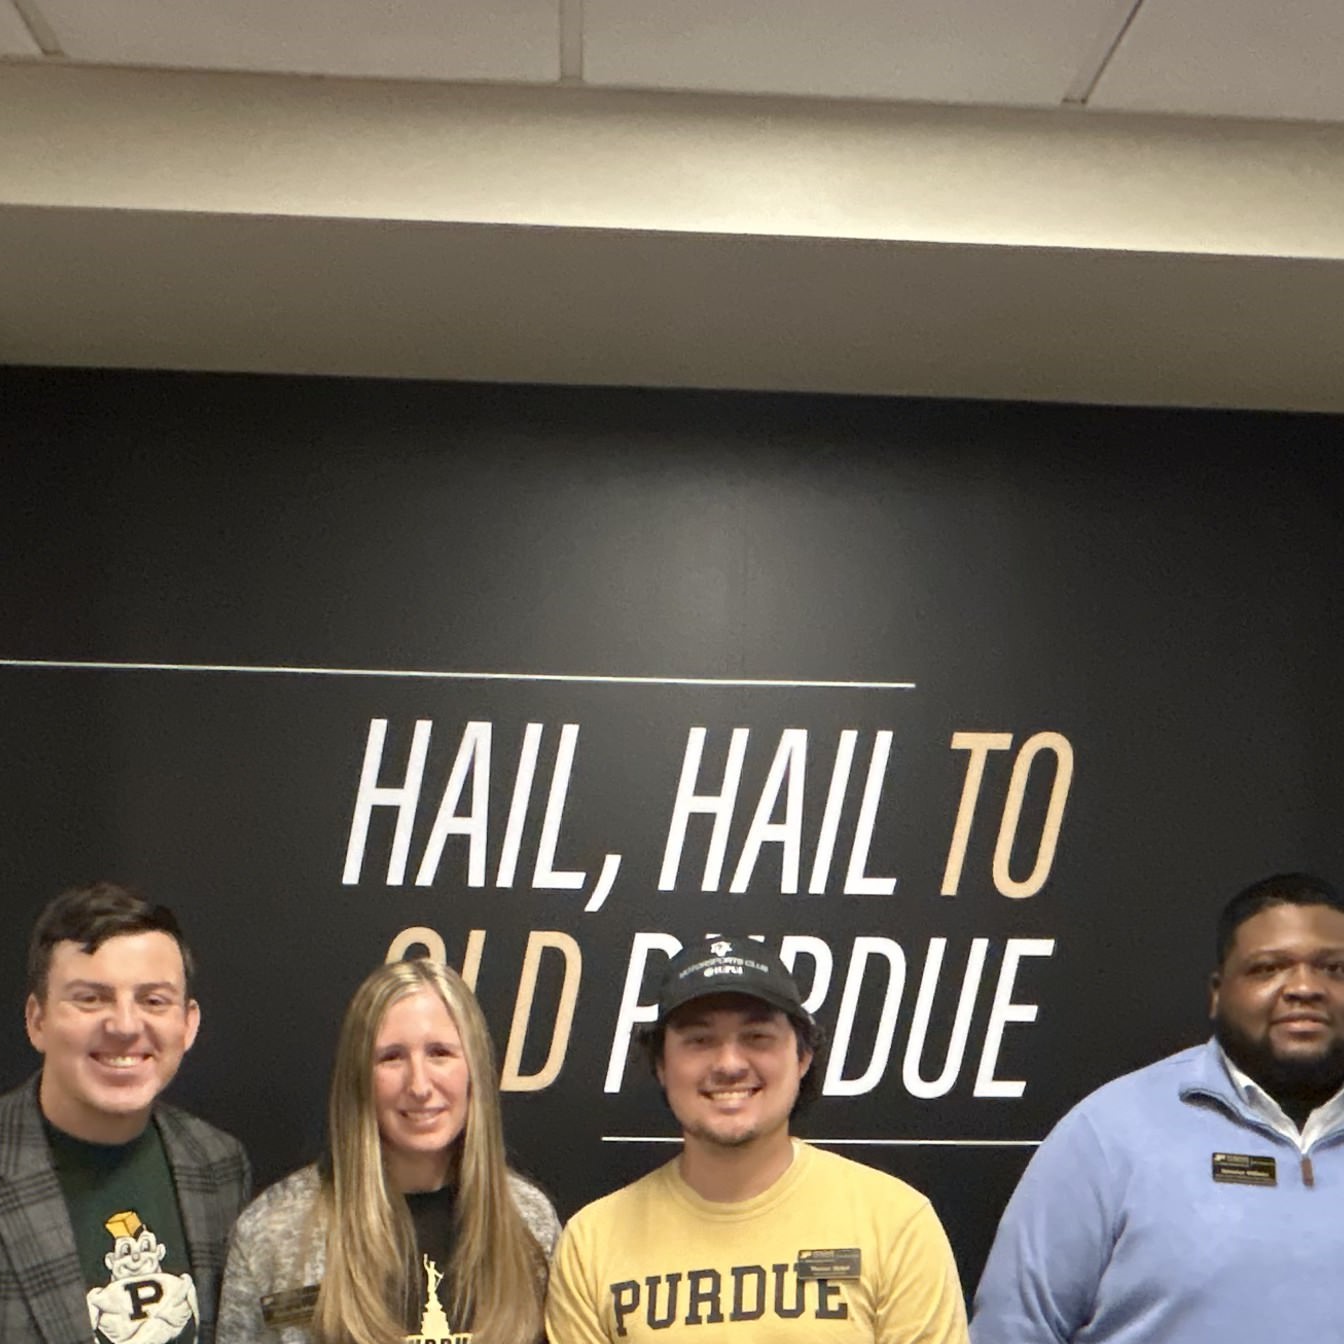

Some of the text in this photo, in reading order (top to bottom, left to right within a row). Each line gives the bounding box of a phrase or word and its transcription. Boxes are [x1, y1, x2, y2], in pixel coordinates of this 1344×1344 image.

[342, 718, 1075, 912] HAIL, HAIL TO
[604, 930, 1054, 1098] PDUE
[124, 1279, 164, 1321] P
[610, 1263, 848, 1337] PURDUE
